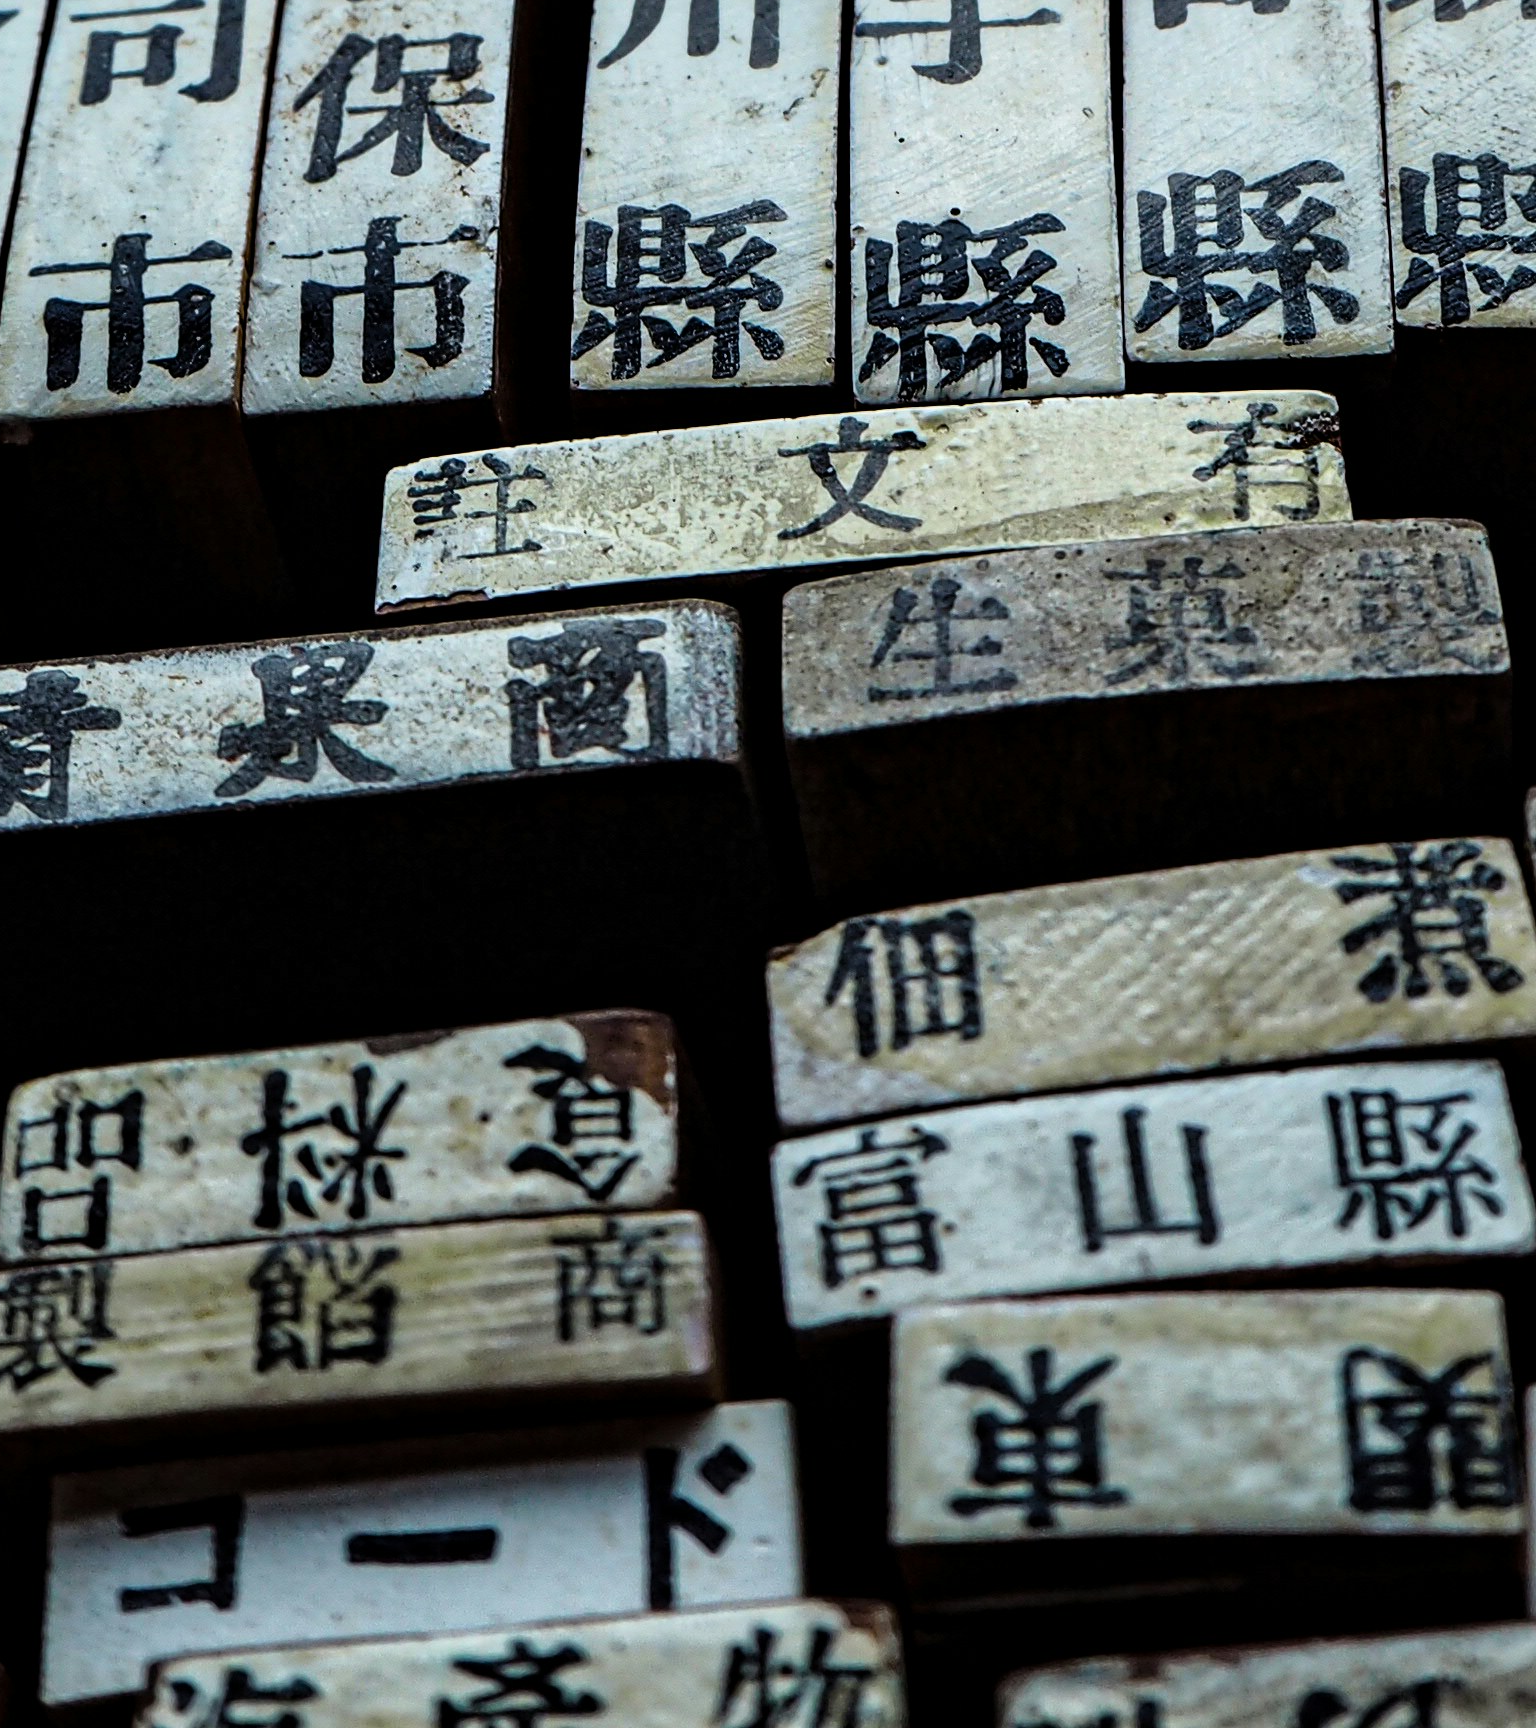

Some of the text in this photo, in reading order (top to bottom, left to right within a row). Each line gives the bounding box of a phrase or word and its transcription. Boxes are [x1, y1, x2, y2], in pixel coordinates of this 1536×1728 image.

[14, 1042, 645, 1255] 食料品
[790, 1088, 1507, 1290] 富山縣
[119, 1441, 752, 1614] コード
